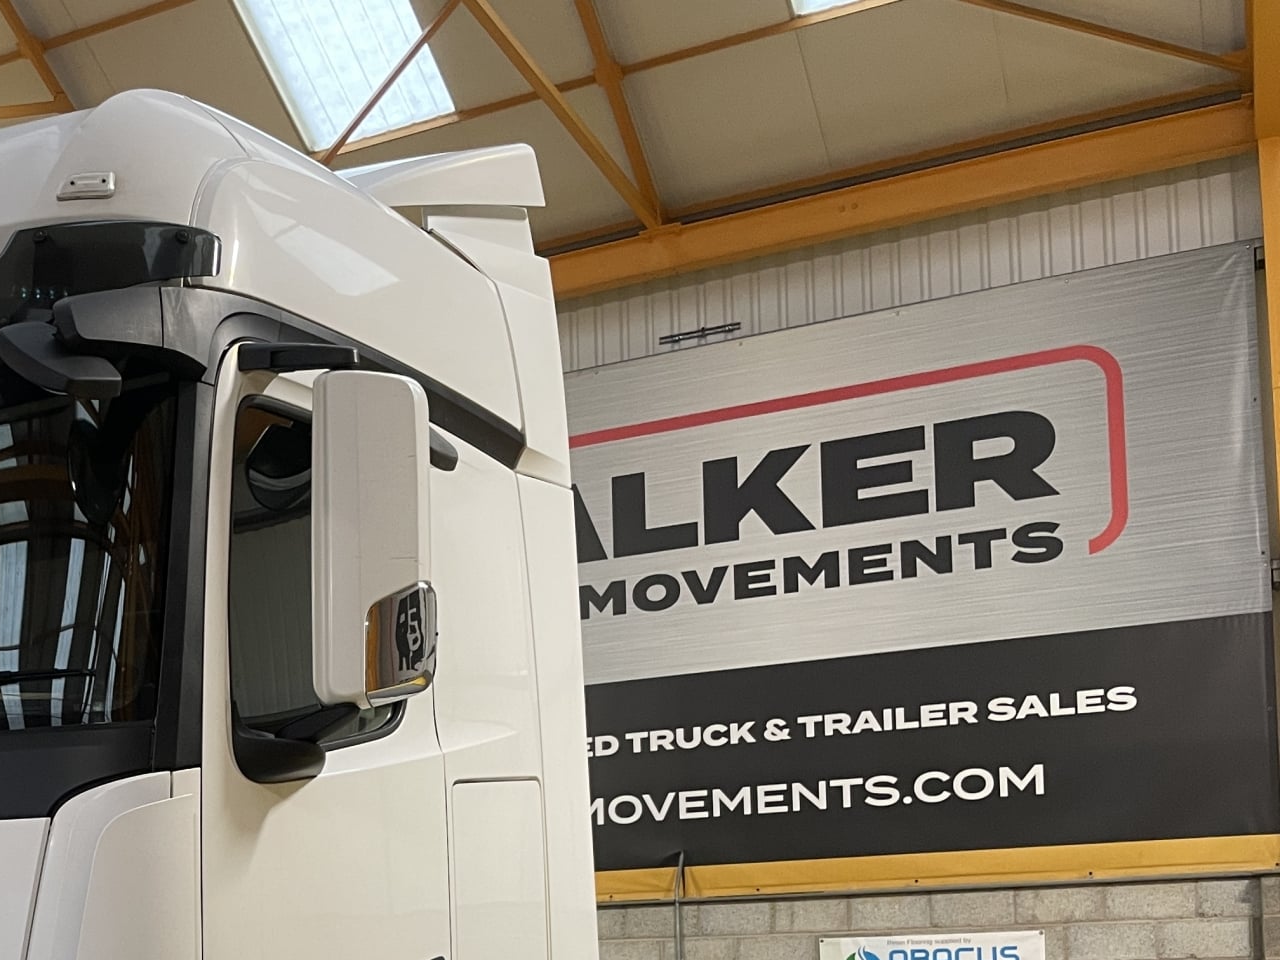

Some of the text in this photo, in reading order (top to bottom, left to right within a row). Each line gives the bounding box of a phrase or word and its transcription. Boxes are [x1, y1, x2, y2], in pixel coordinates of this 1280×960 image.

[579, 521, 1064, 620] MOVEMENTS
[624, 720, 757, 754] TRUCK
[762, 718, 792, 742] &
[796, 700, 979, 738] TRAILER
[987, 686, 1138, 722] SALES
